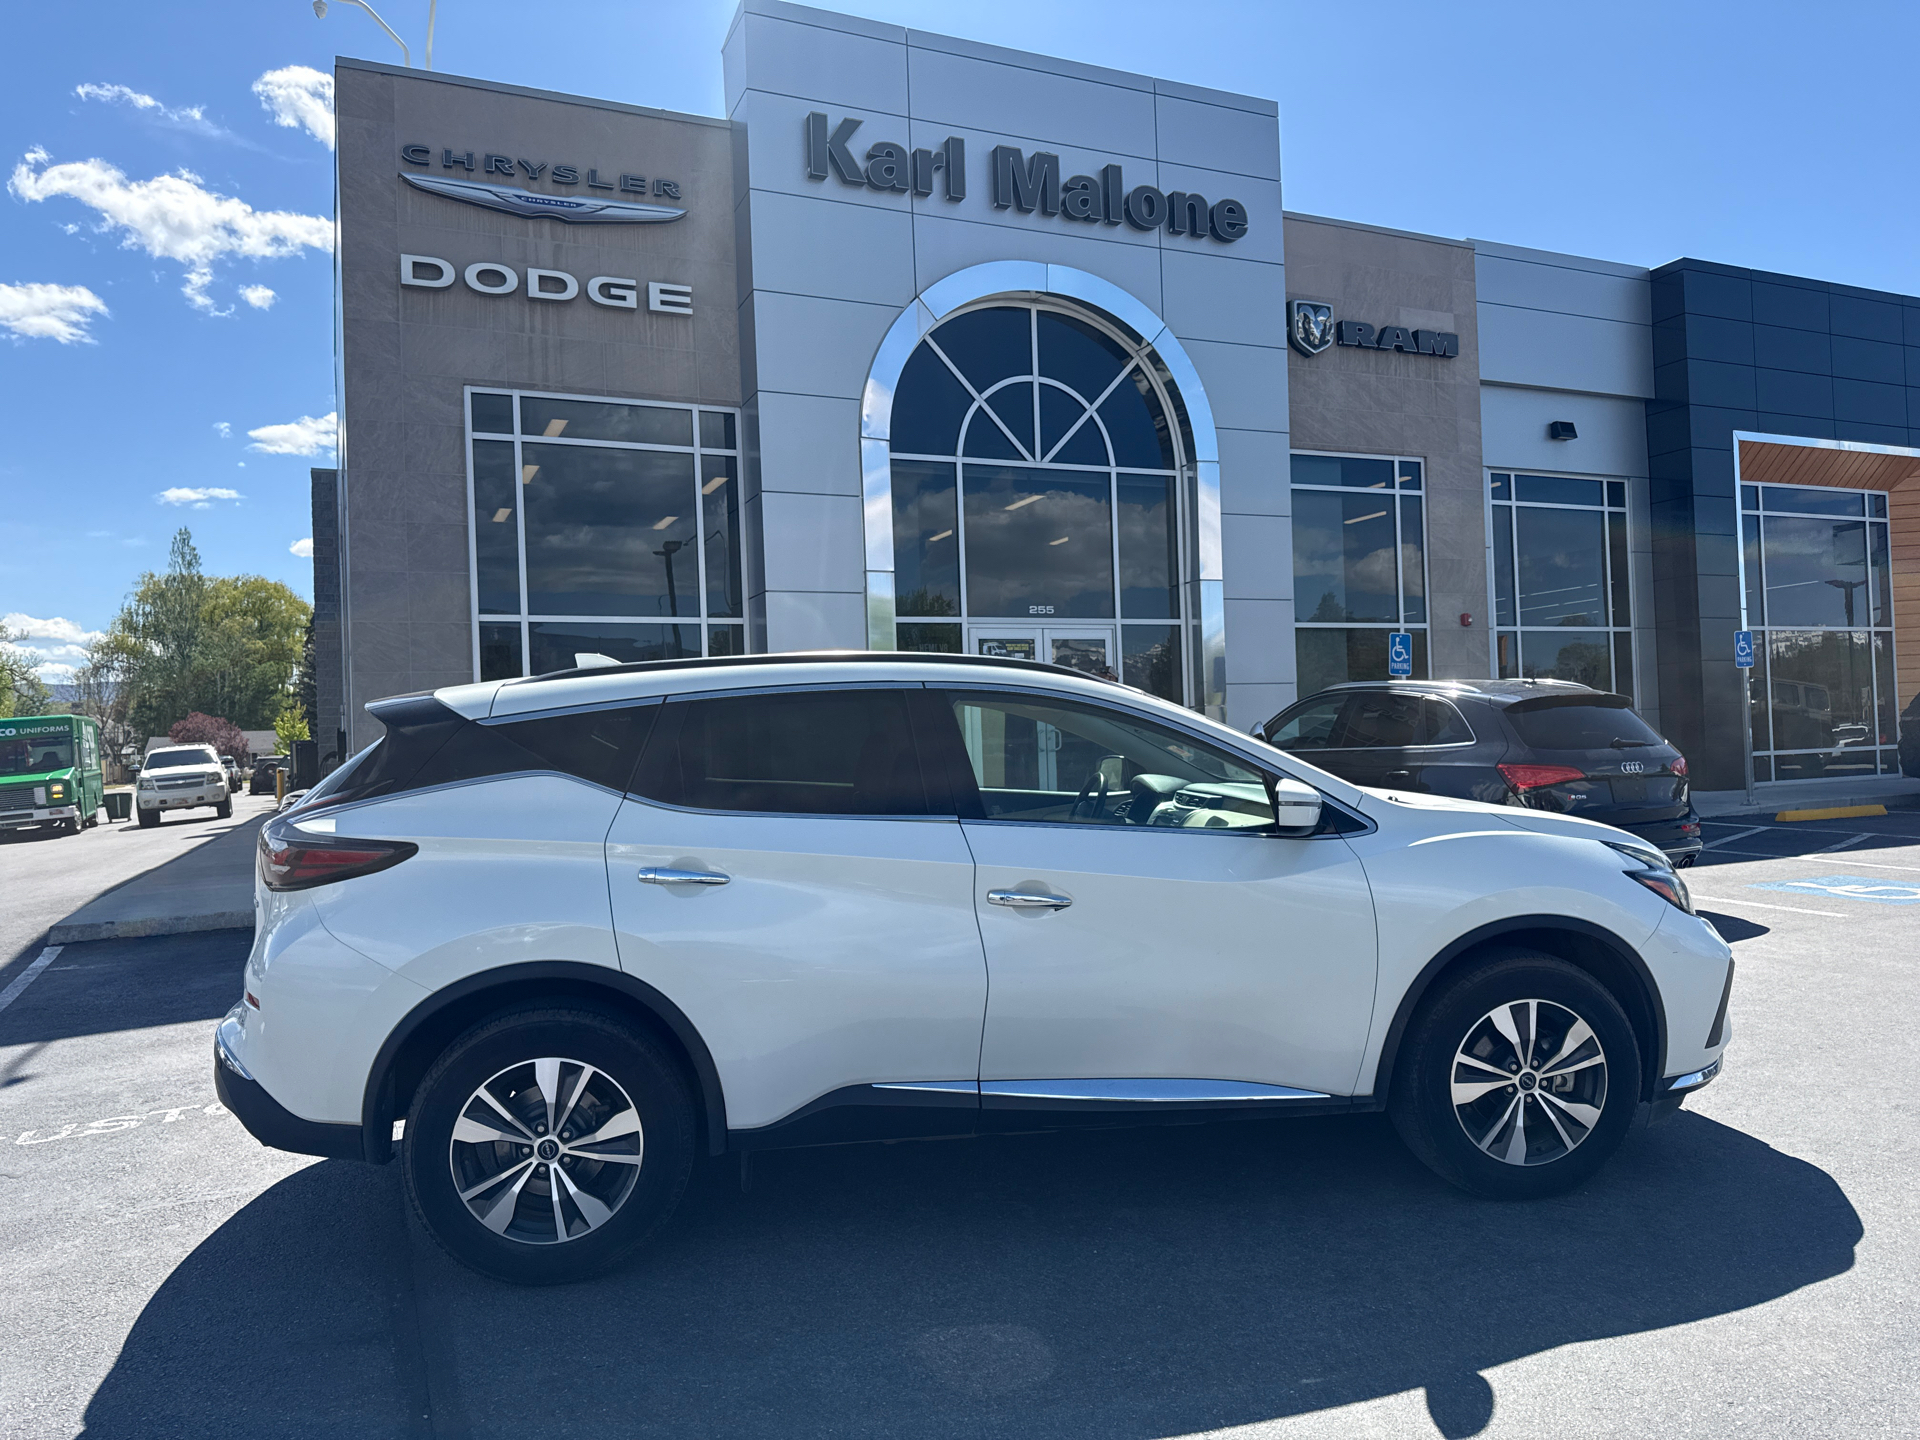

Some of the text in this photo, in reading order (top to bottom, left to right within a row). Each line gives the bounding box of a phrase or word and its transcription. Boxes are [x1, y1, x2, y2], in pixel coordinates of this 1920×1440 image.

[401, 144, 682, 199] CHRYSLER
[806, 110, 1249, 244] Karl Malone
[521, 196, 577, 208] CHRYSLER
[400, 253, 694, 316] DODGE
[1336, 320, 1459, 359] RAM
[1028, 605, 1055, 614] 255
[1391, 662, 1410, 671] PARKING
[0, 724, 70, 737] CO UNIFORMS
